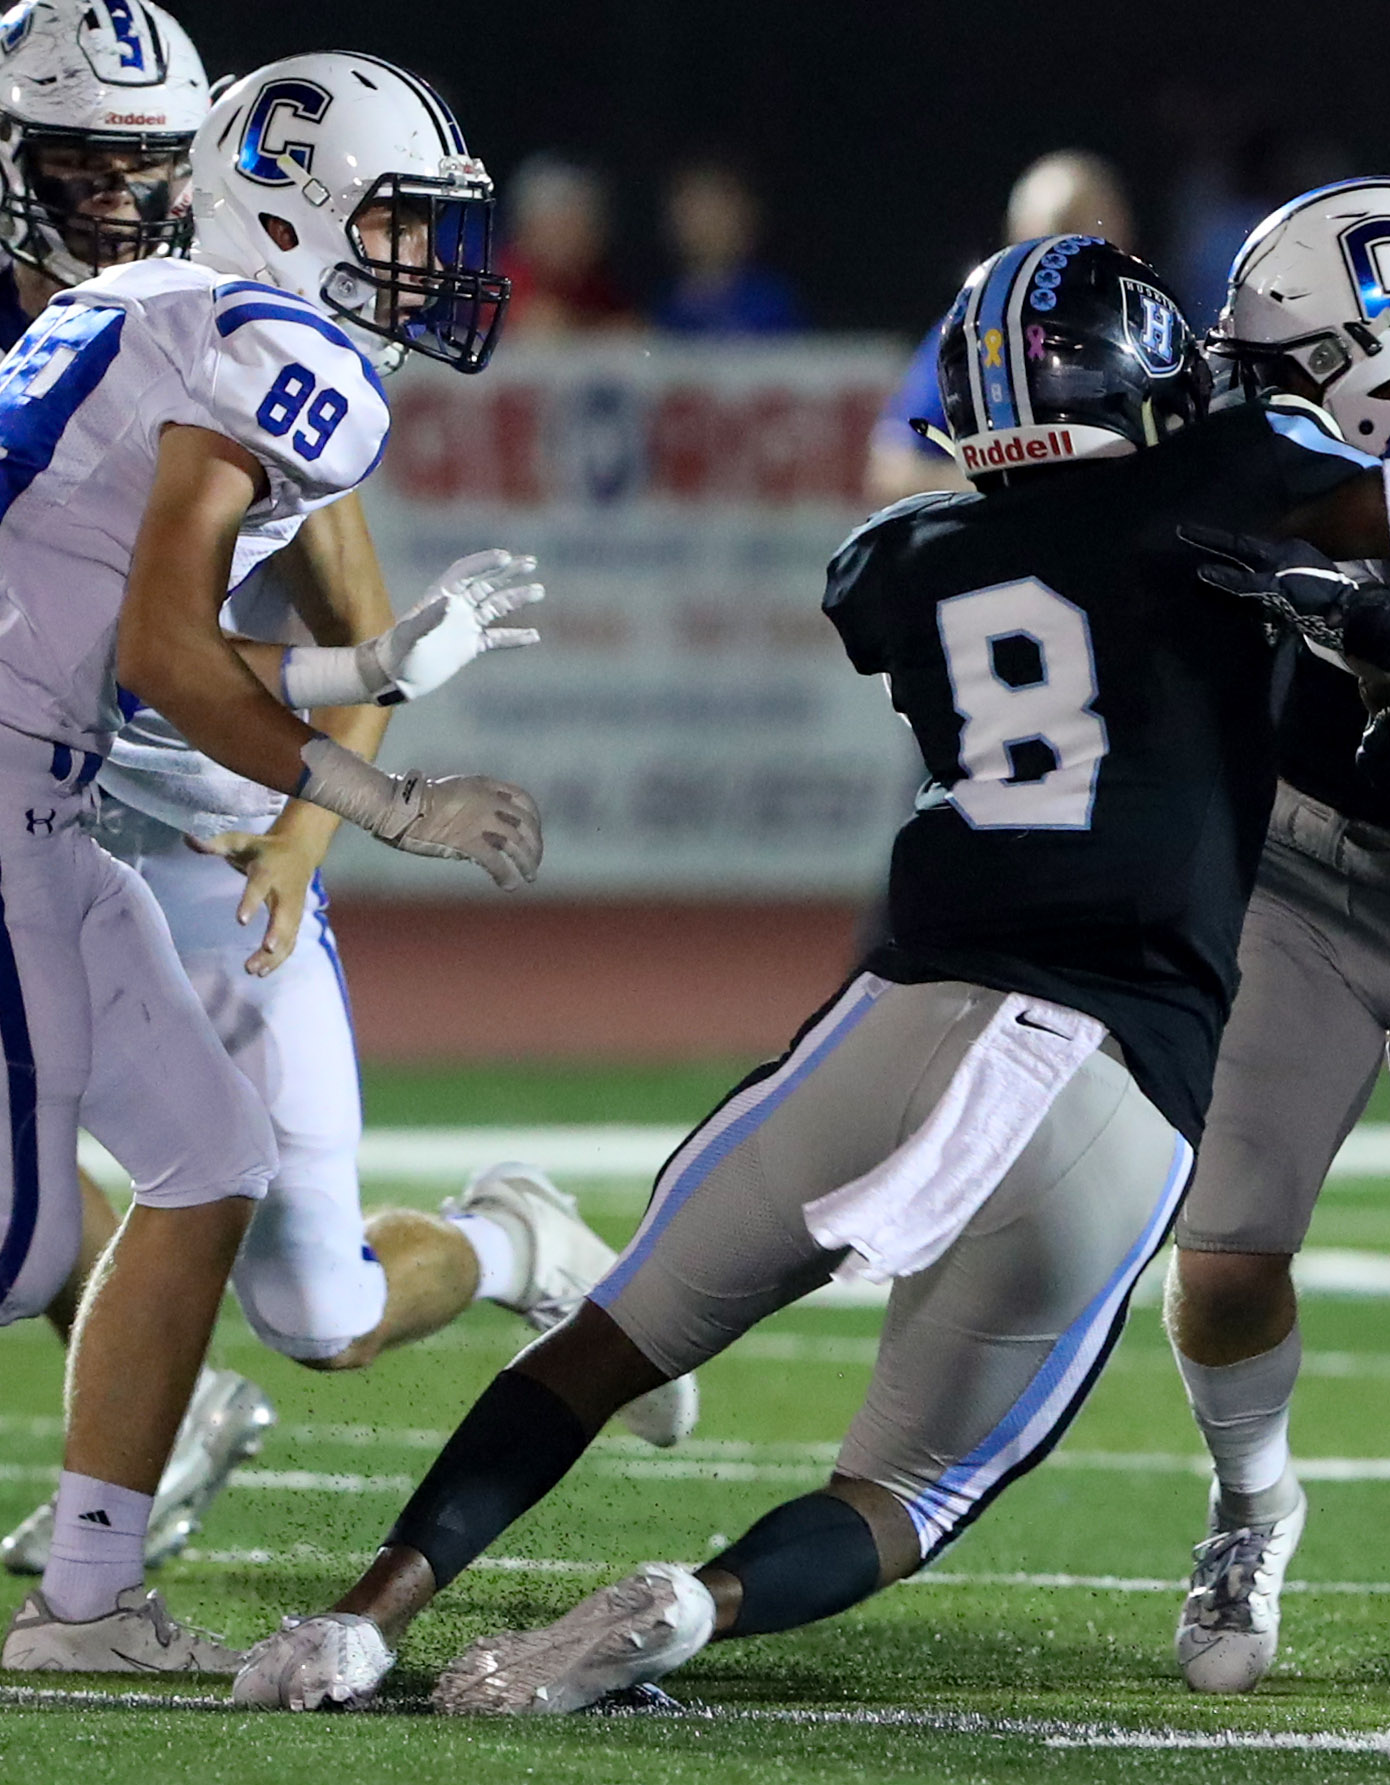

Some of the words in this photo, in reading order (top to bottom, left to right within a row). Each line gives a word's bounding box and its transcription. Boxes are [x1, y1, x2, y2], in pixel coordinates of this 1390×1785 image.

[105, 112, 167, 126] Riddell
[235, 78, 334, 187] C
[1140, 294, 1173, 364] H
[256, 362, 348, 462] 89
[962, 430, 1073, 470] Riddell
[936, 575, 1110, 831] 8
